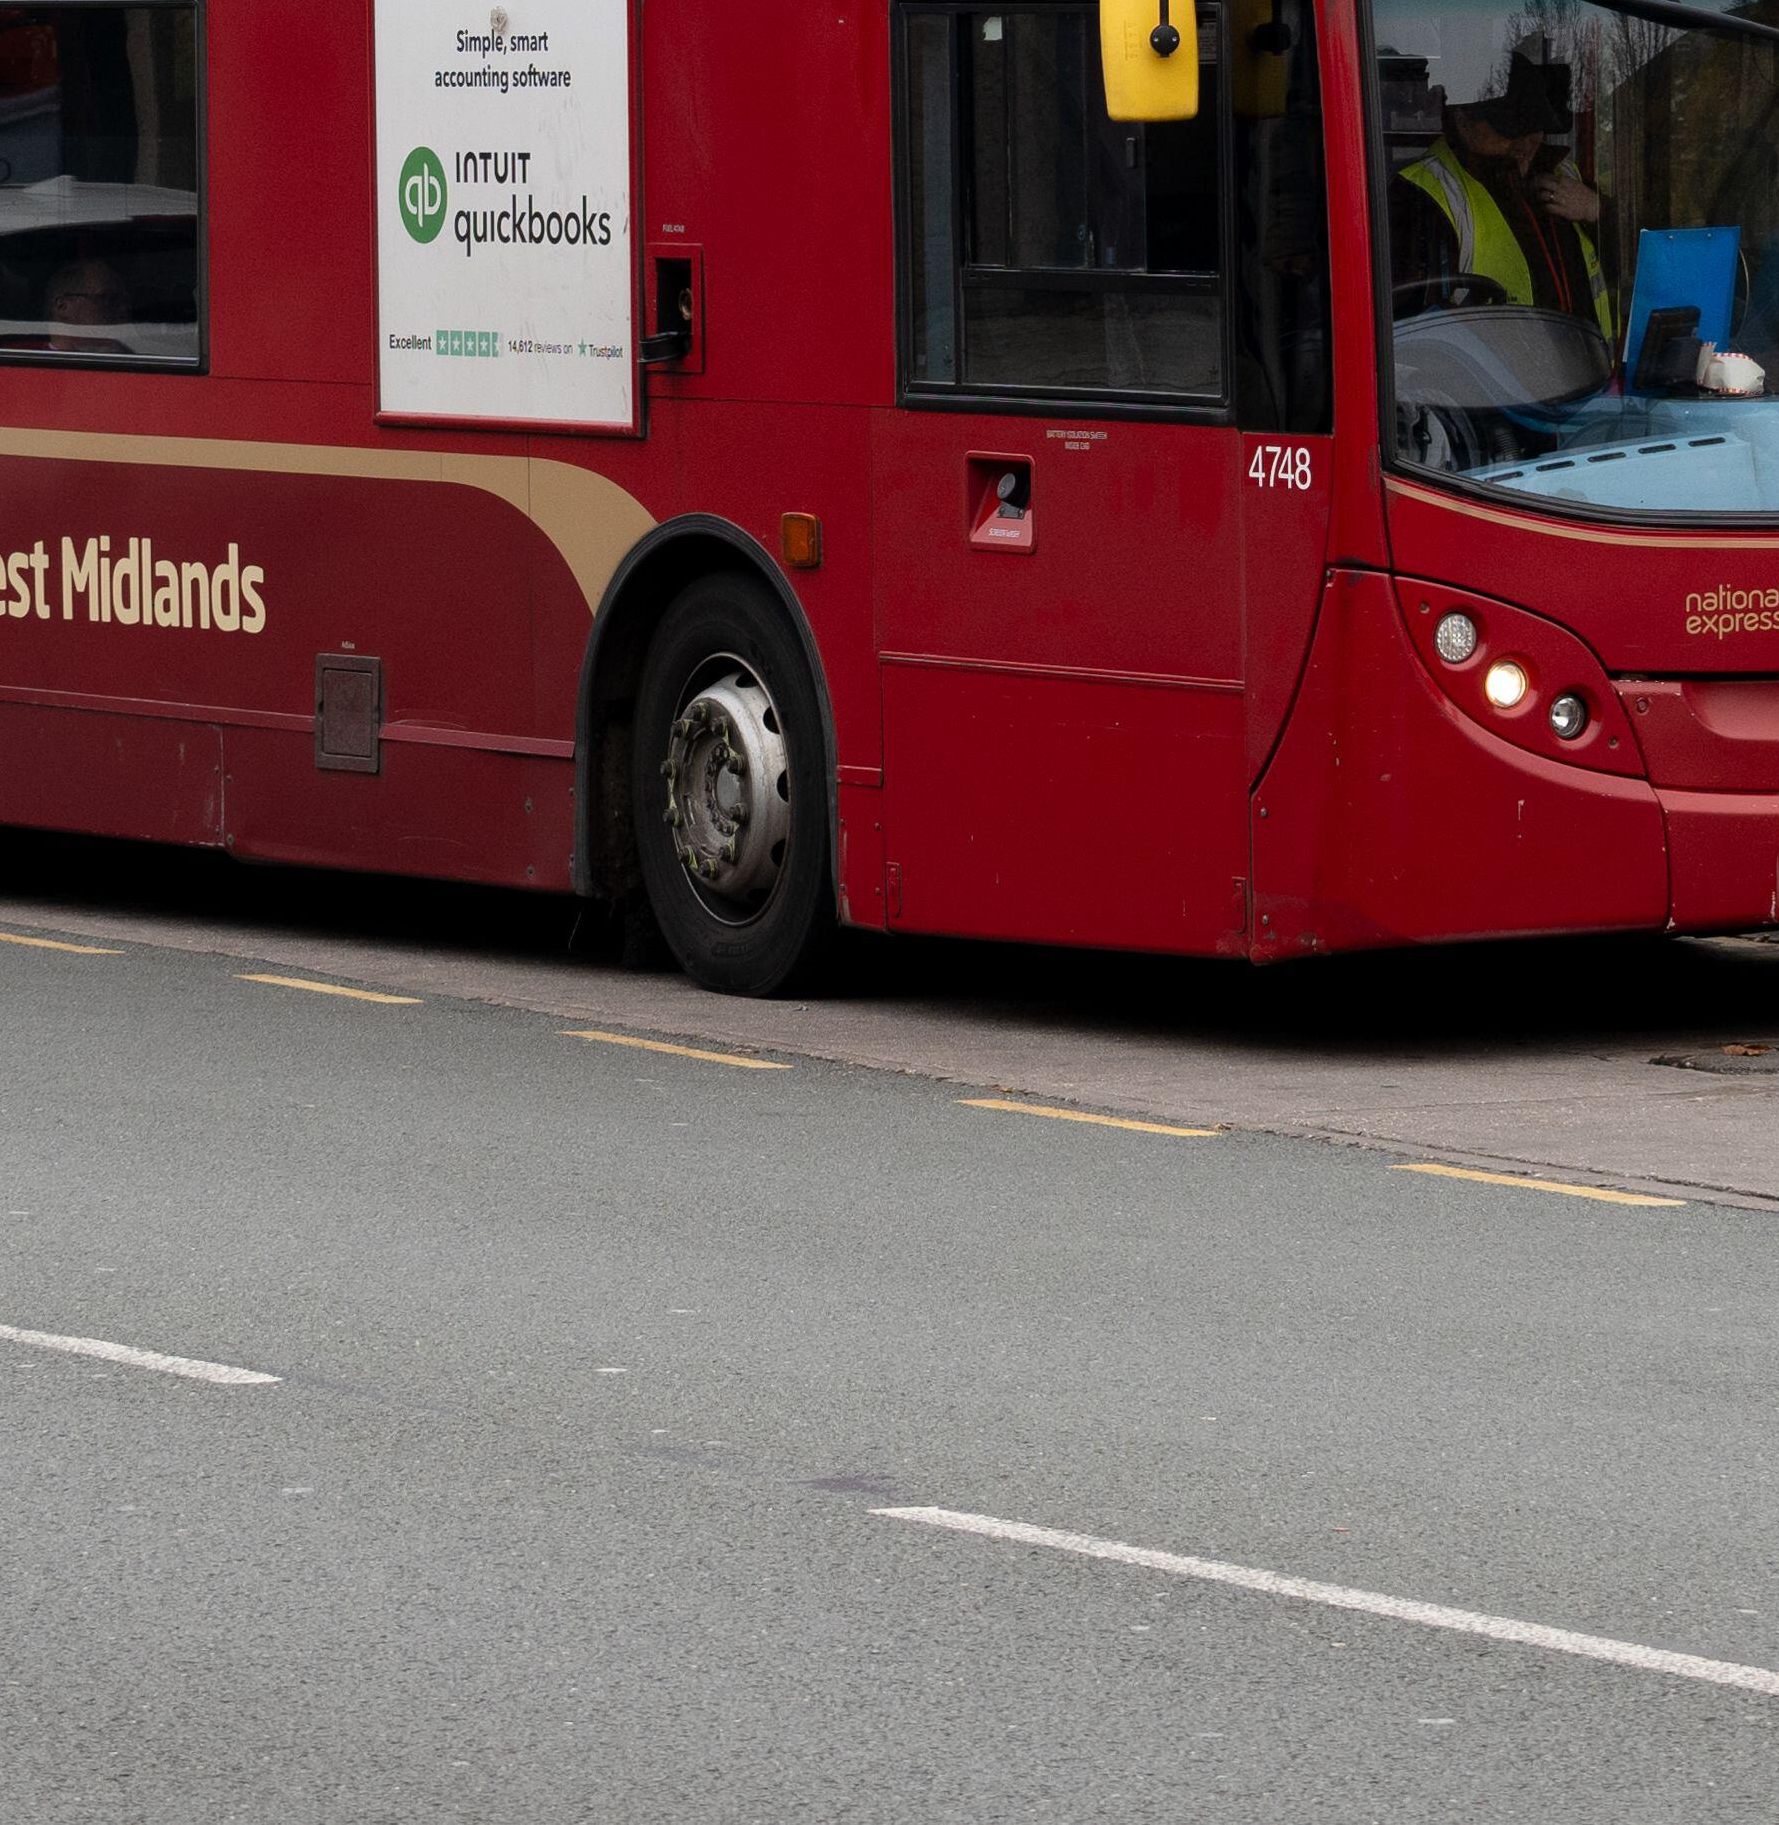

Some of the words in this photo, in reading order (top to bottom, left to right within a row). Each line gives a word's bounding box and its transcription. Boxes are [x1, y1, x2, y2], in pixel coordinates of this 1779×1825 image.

[456, 29, 507, 58] Simple,
[510, 31, 549, 52] smart
[435, 64, 509, 94] accounting
[512, 63, 572, 87] software
[454, 194, 611, 257] quickbooks
[389, 333, 432, 351] Excellent
[534, 340, 562, 354] reviews
[564, 343, 573, 354] on
[589, 343, 624, 360] Trustpilot
[1248, 445, 1312, 490] 4748
[61, 535, 266, 634] Midlands
